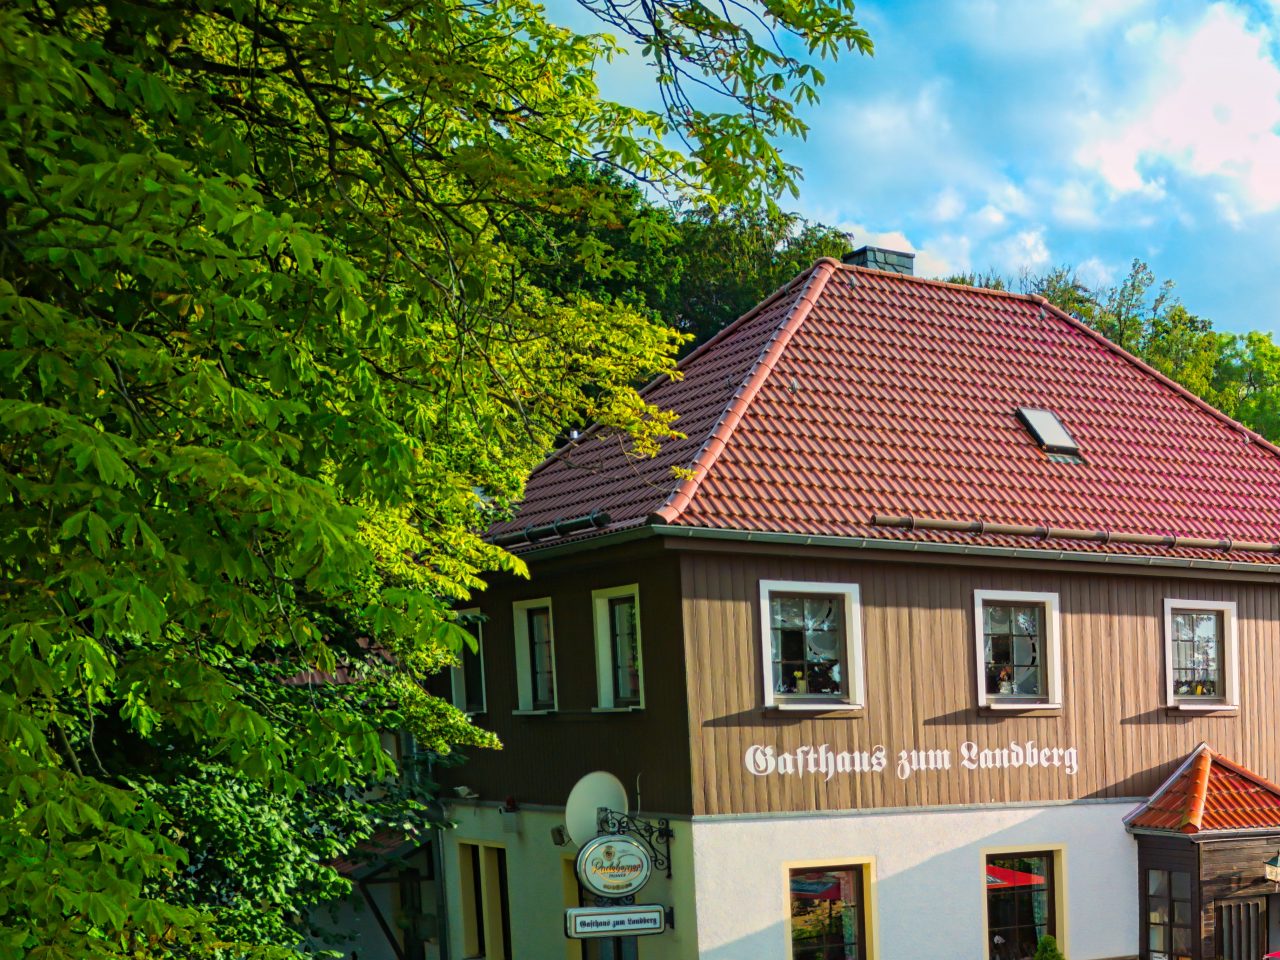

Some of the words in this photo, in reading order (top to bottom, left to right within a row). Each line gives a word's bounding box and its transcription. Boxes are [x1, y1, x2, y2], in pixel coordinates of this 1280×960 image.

[897, 748, 951, 780] zum
[959, 740, 1079, 775] Landberg
[591, 856, 641, 875] Radeberger
[612, 918, 626, 928] zum
[627, 915, 658, 926] Landberg
